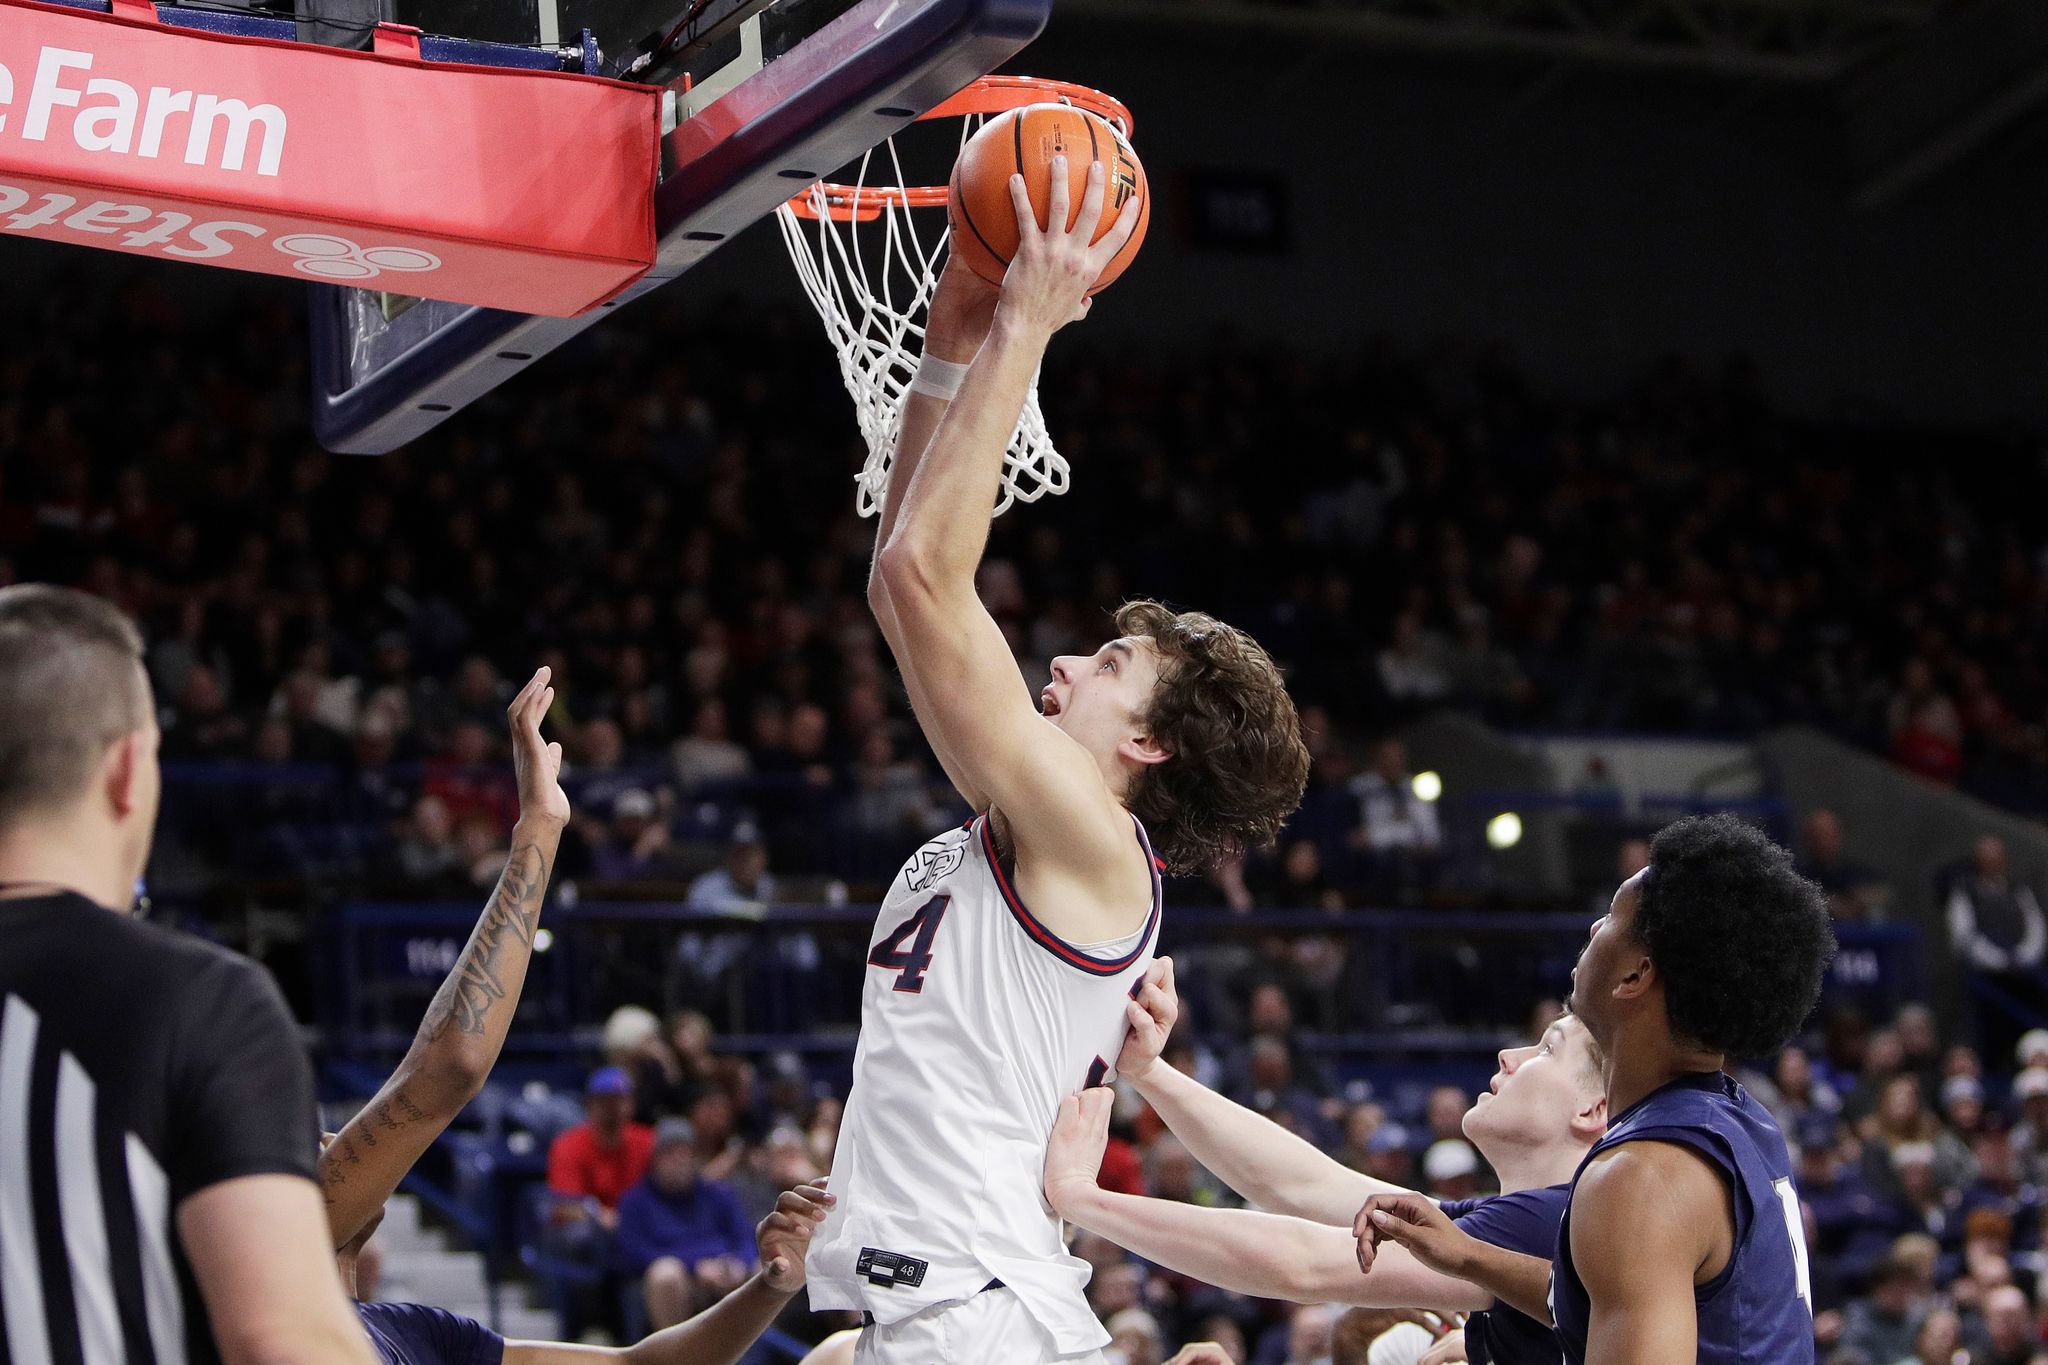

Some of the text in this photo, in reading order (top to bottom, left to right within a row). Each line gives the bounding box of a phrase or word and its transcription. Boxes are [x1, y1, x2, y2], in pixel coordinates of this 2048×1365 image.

[22, 46, 287, 176] Farm
[867, 894, 951, 994] 4
[900, 1264, 915, 1277] 48
